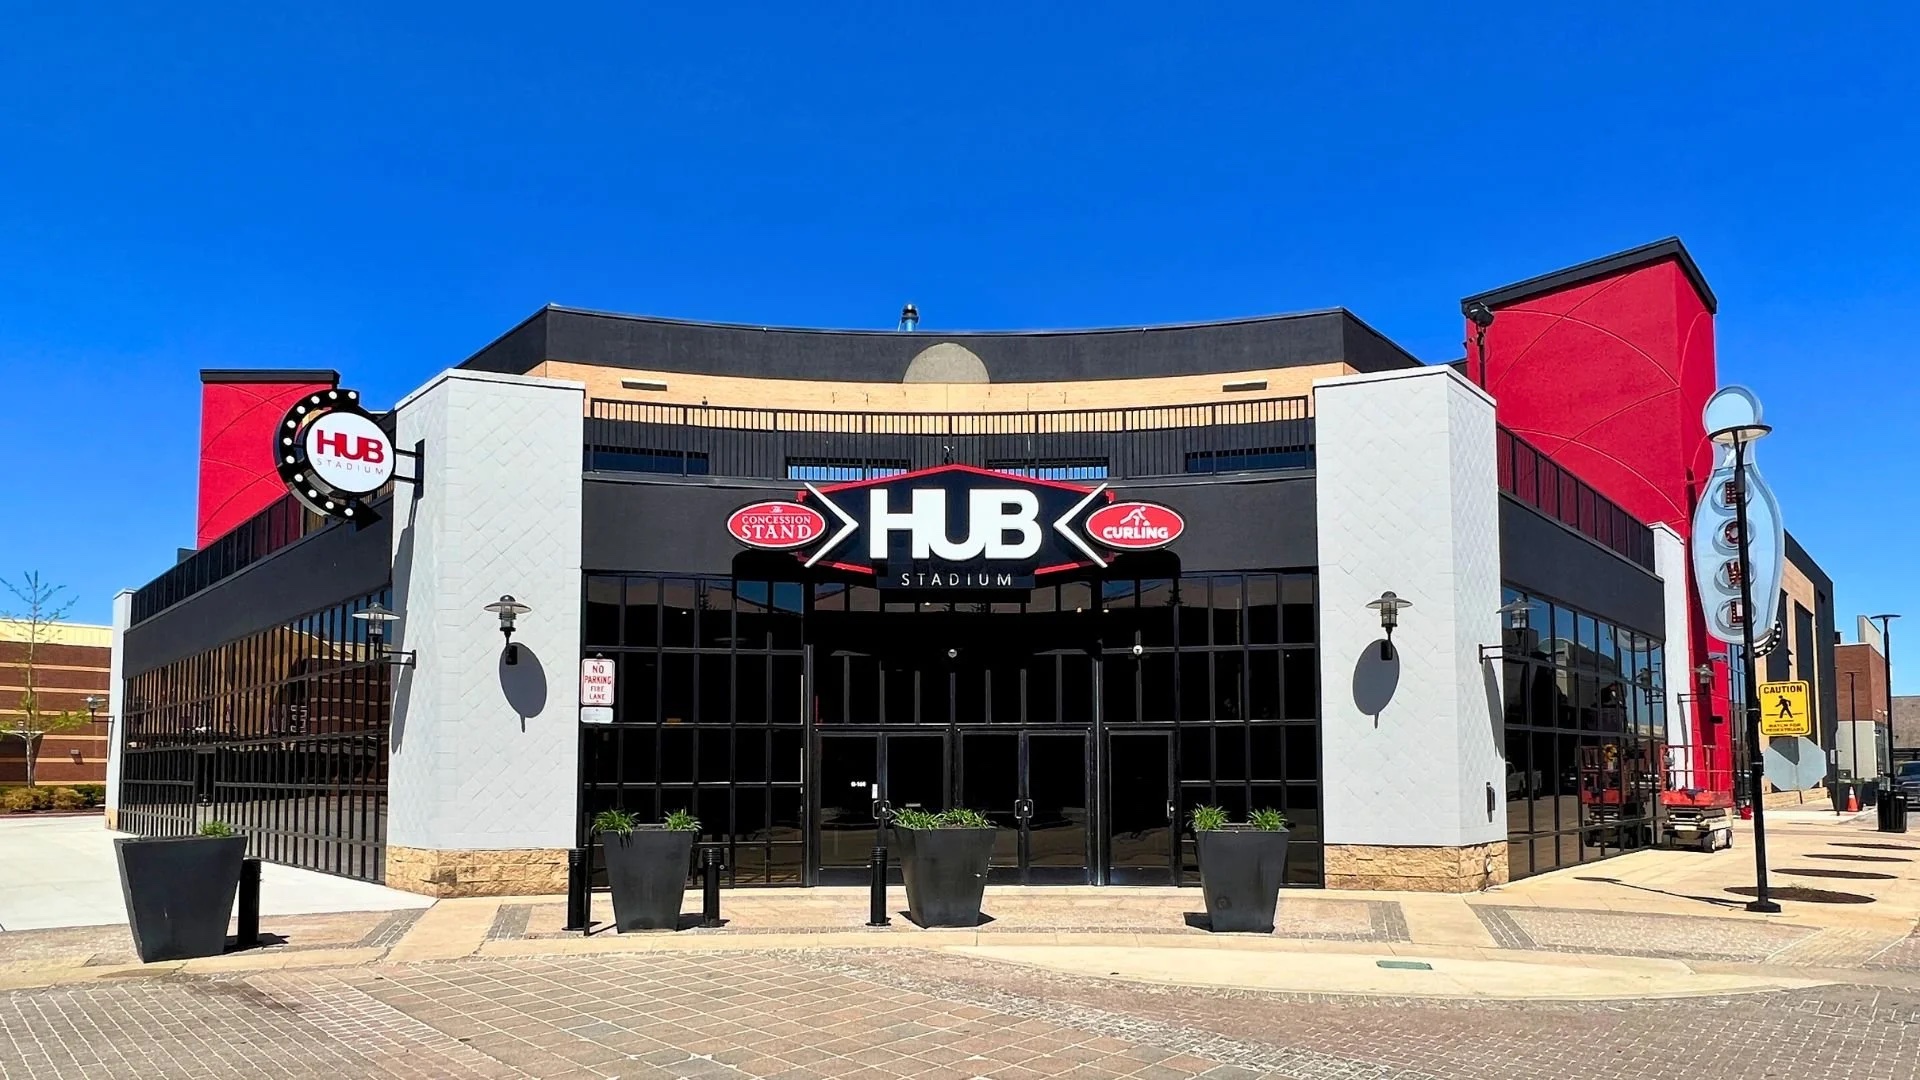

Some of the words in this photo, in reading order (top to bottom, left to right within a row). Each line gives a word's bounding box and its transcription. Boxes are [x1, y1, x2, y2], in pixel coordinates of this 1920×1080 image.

[317, 429, 384, 463] HUB
[317, 458, 384, 475] STADIUM
[741, 515, 811, 525] CONCESSION
[869, 488, 1043, 561] HUB
[741, 524, 812, 539] STAND
[1102, 526, 1169, 540] CURLING
[901, 573, 1011, 586] STADIUM
[592, 665, 605, 674] NO
[584, 675, 612, 685] PARKING
[1763, 685, 1803, 694] CAUTION
